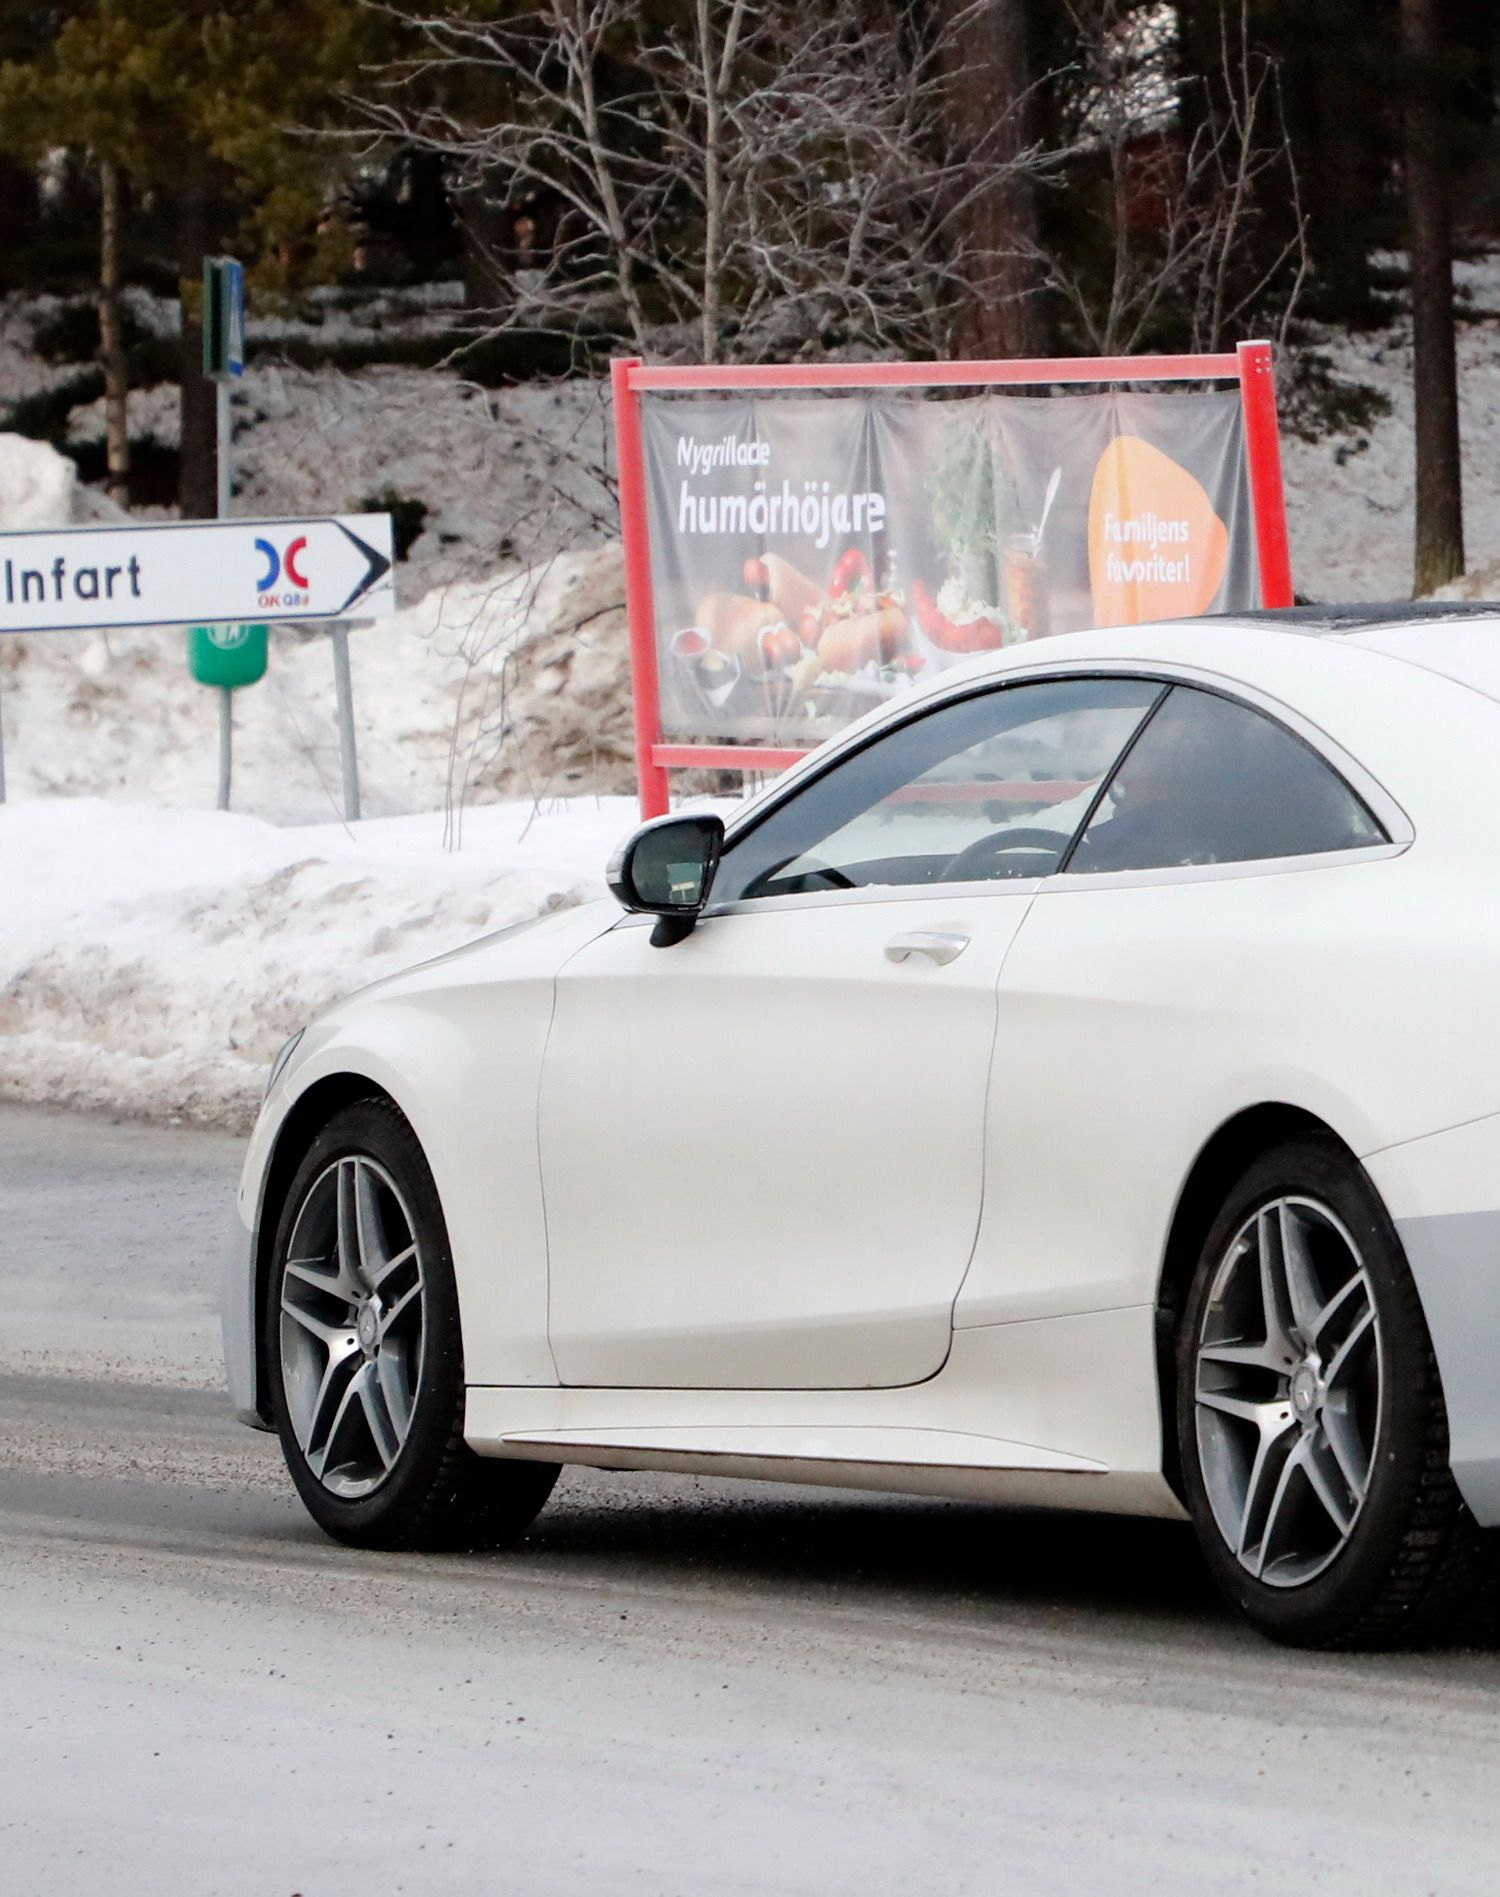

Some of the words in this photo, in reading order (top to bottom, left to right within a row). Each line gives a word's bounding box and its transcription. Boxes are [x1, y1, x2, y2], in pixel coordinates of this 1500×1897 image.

[677, 434, 770, 475] Nygrillade
[679, 480, 886, 549] humörhöjare
[1104, 512, 1189, 550] Familjens
[5, 555, 141, 603] Infart
[1106, 552, 1191, 583] favoriter!
